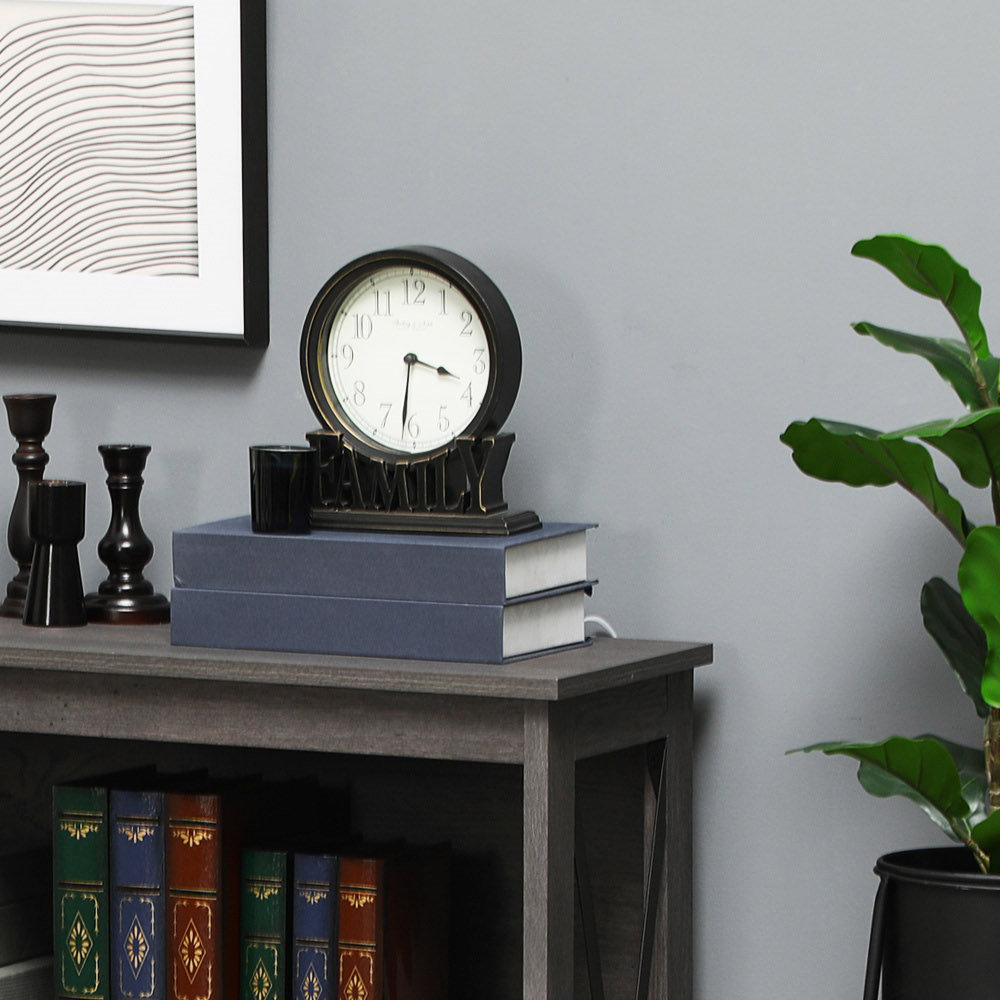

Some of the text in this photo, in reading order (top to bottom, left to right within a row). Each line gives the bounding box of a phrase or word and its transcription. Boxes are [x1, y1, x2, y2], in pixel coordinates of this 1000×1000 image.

[373, 289, 392, 317] 11
[401, 278, 426, 306] 12
[439, 289, 449, 316] 1
[352, 313, 373, 340] 10
[459, 311, 474, 337] 2
[342, 344, 354, 370] 9
[473, 348, 486, 375] 3
[353, 380, 366, 407] 8
[459, 381, 473, 408] 4
[379, 403, 393, 429] 7
[407, 413, 420, 439] 6
[438, 405, 450, 432] 5
[306, 432, 500, 514] FAMILY
